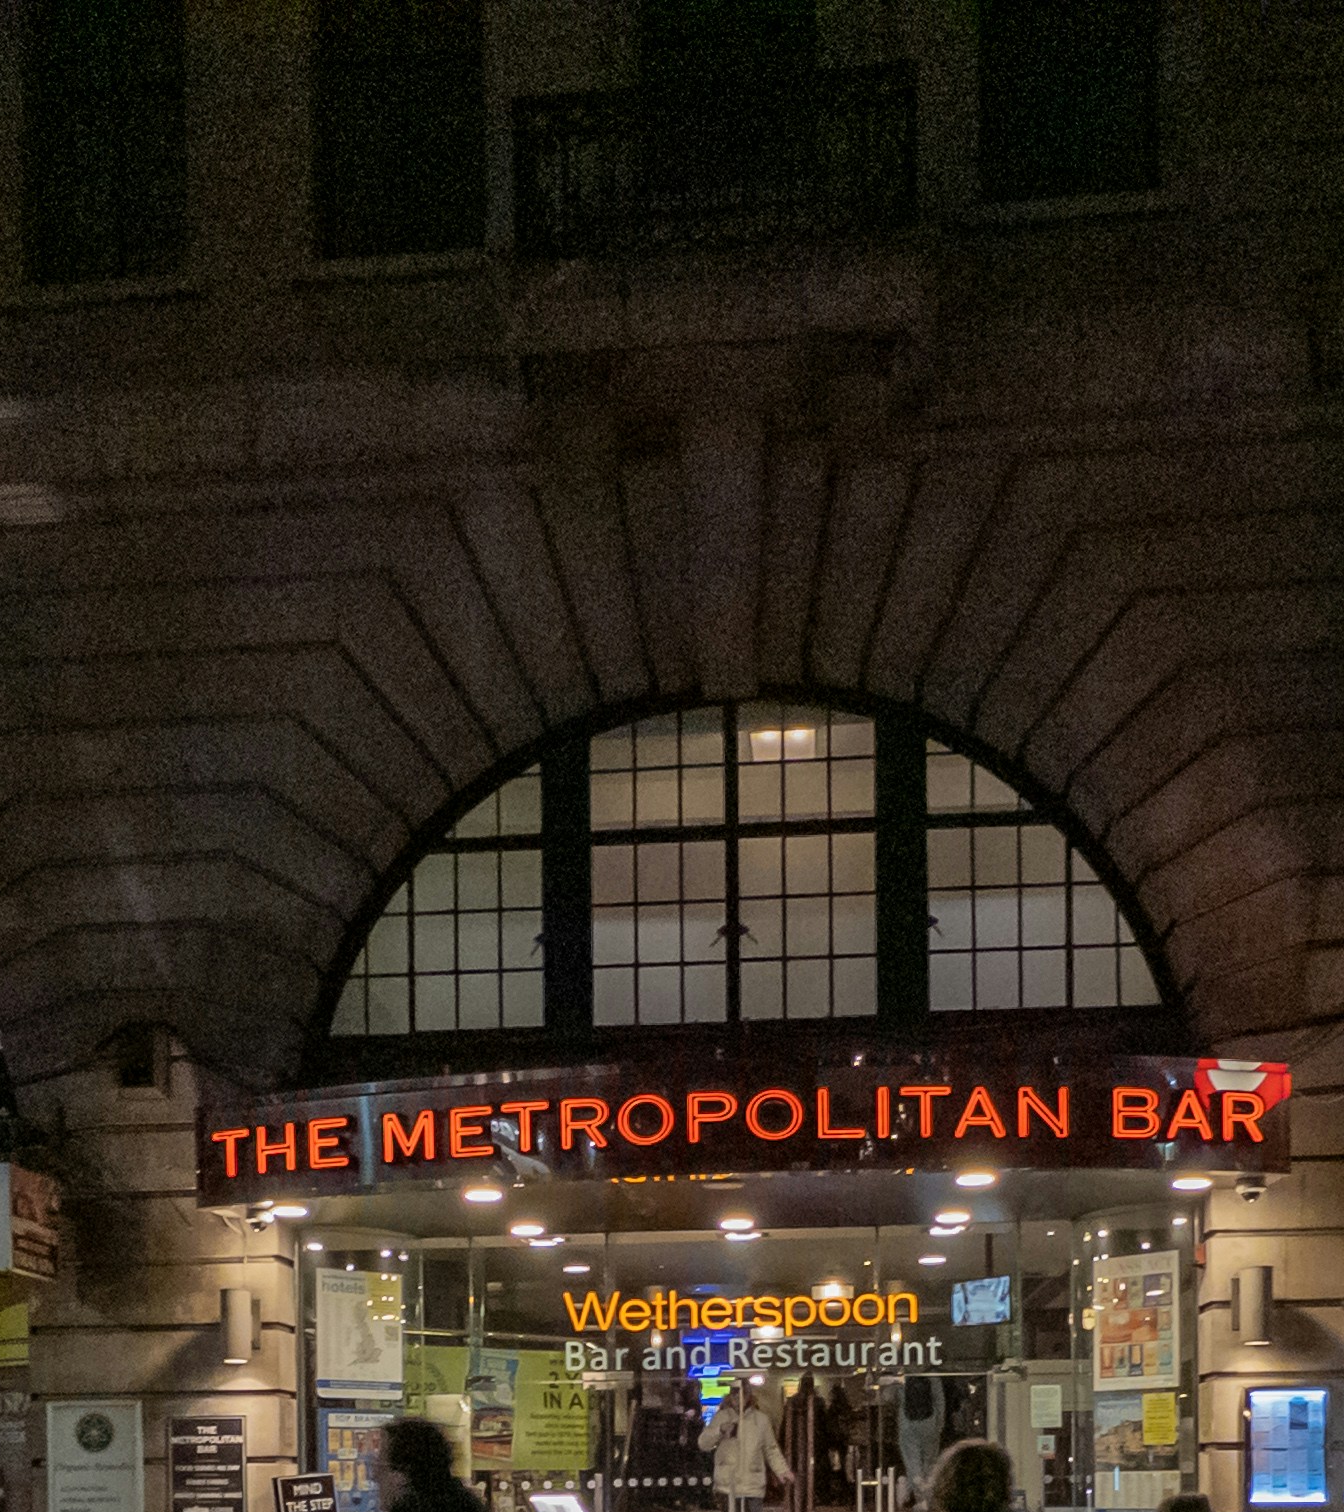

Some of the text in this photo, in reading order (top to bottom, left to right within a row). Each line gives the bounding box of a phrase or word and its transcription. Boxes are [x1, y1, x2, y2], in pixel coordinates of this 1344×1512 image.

[212, 1086, 1265, 1178] THE METROPOLITAN BAR
[322, 1281, 365, 1295] hotels
[563, 1289, 919, 1337] Wetherspoon
[565, 1336, 943, 1371] Bar and Restaurant
[543, 1392, 562, 1409] IN
[292, 1483, 323, 1497] MIND
[309, 1497, 334, 1512] STEP
